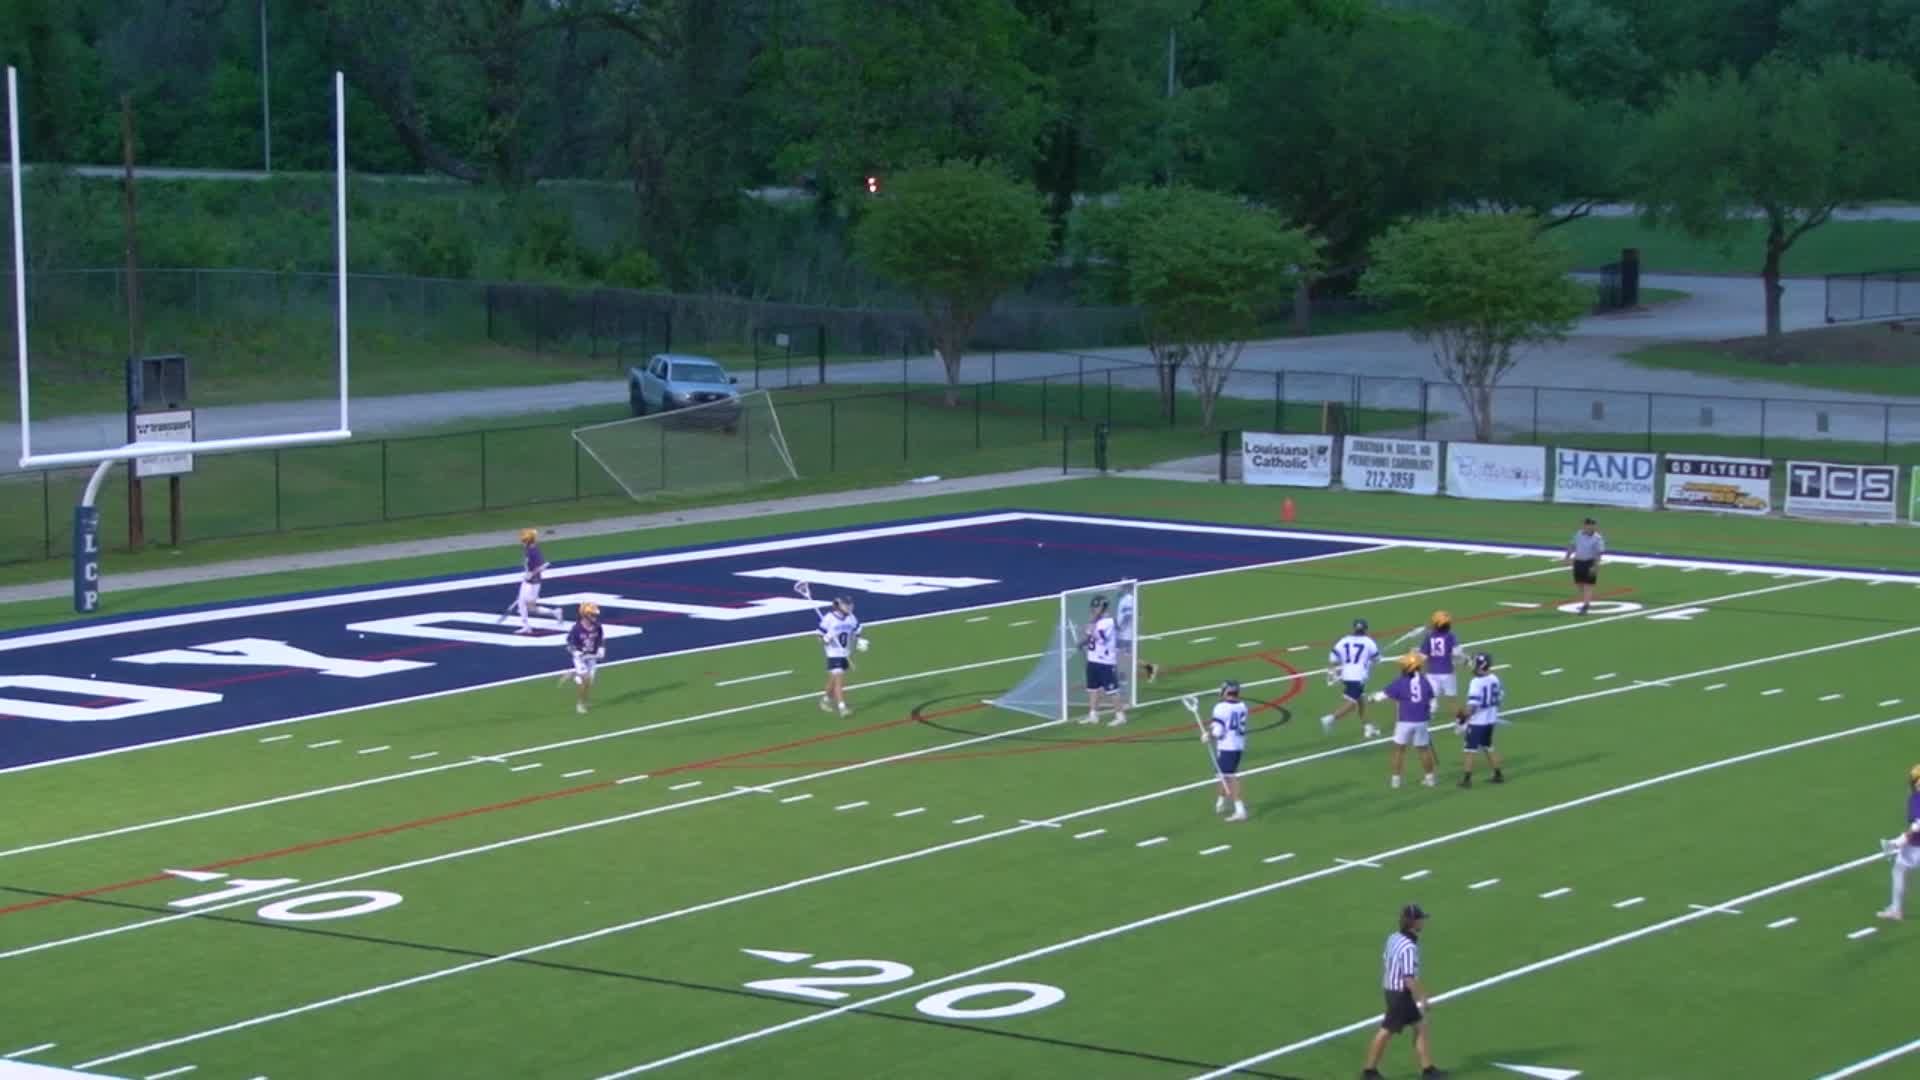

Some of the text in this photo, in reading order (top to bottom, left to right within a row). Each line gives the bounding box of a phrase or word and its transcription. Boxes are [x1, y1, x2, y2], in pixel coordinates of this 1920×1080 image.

[1244, 441, 1308, 456] Louisiana
[1252, 455, 1308, 470] Catholic
[1558, 452, 1653, 480] HAND
[1671, 461, 1766, 478] GO FLYERS!
[1559, 478, 1652, 494] CONSTRUCTION
[1793, 469, 1891, 499] TCS
[1343, 642, 1366, 665] 17
[1430, 637, 1446, 657] 13
[1410, 674, 1422, 704] 9
[742, 959, 1066, 1019] 20
